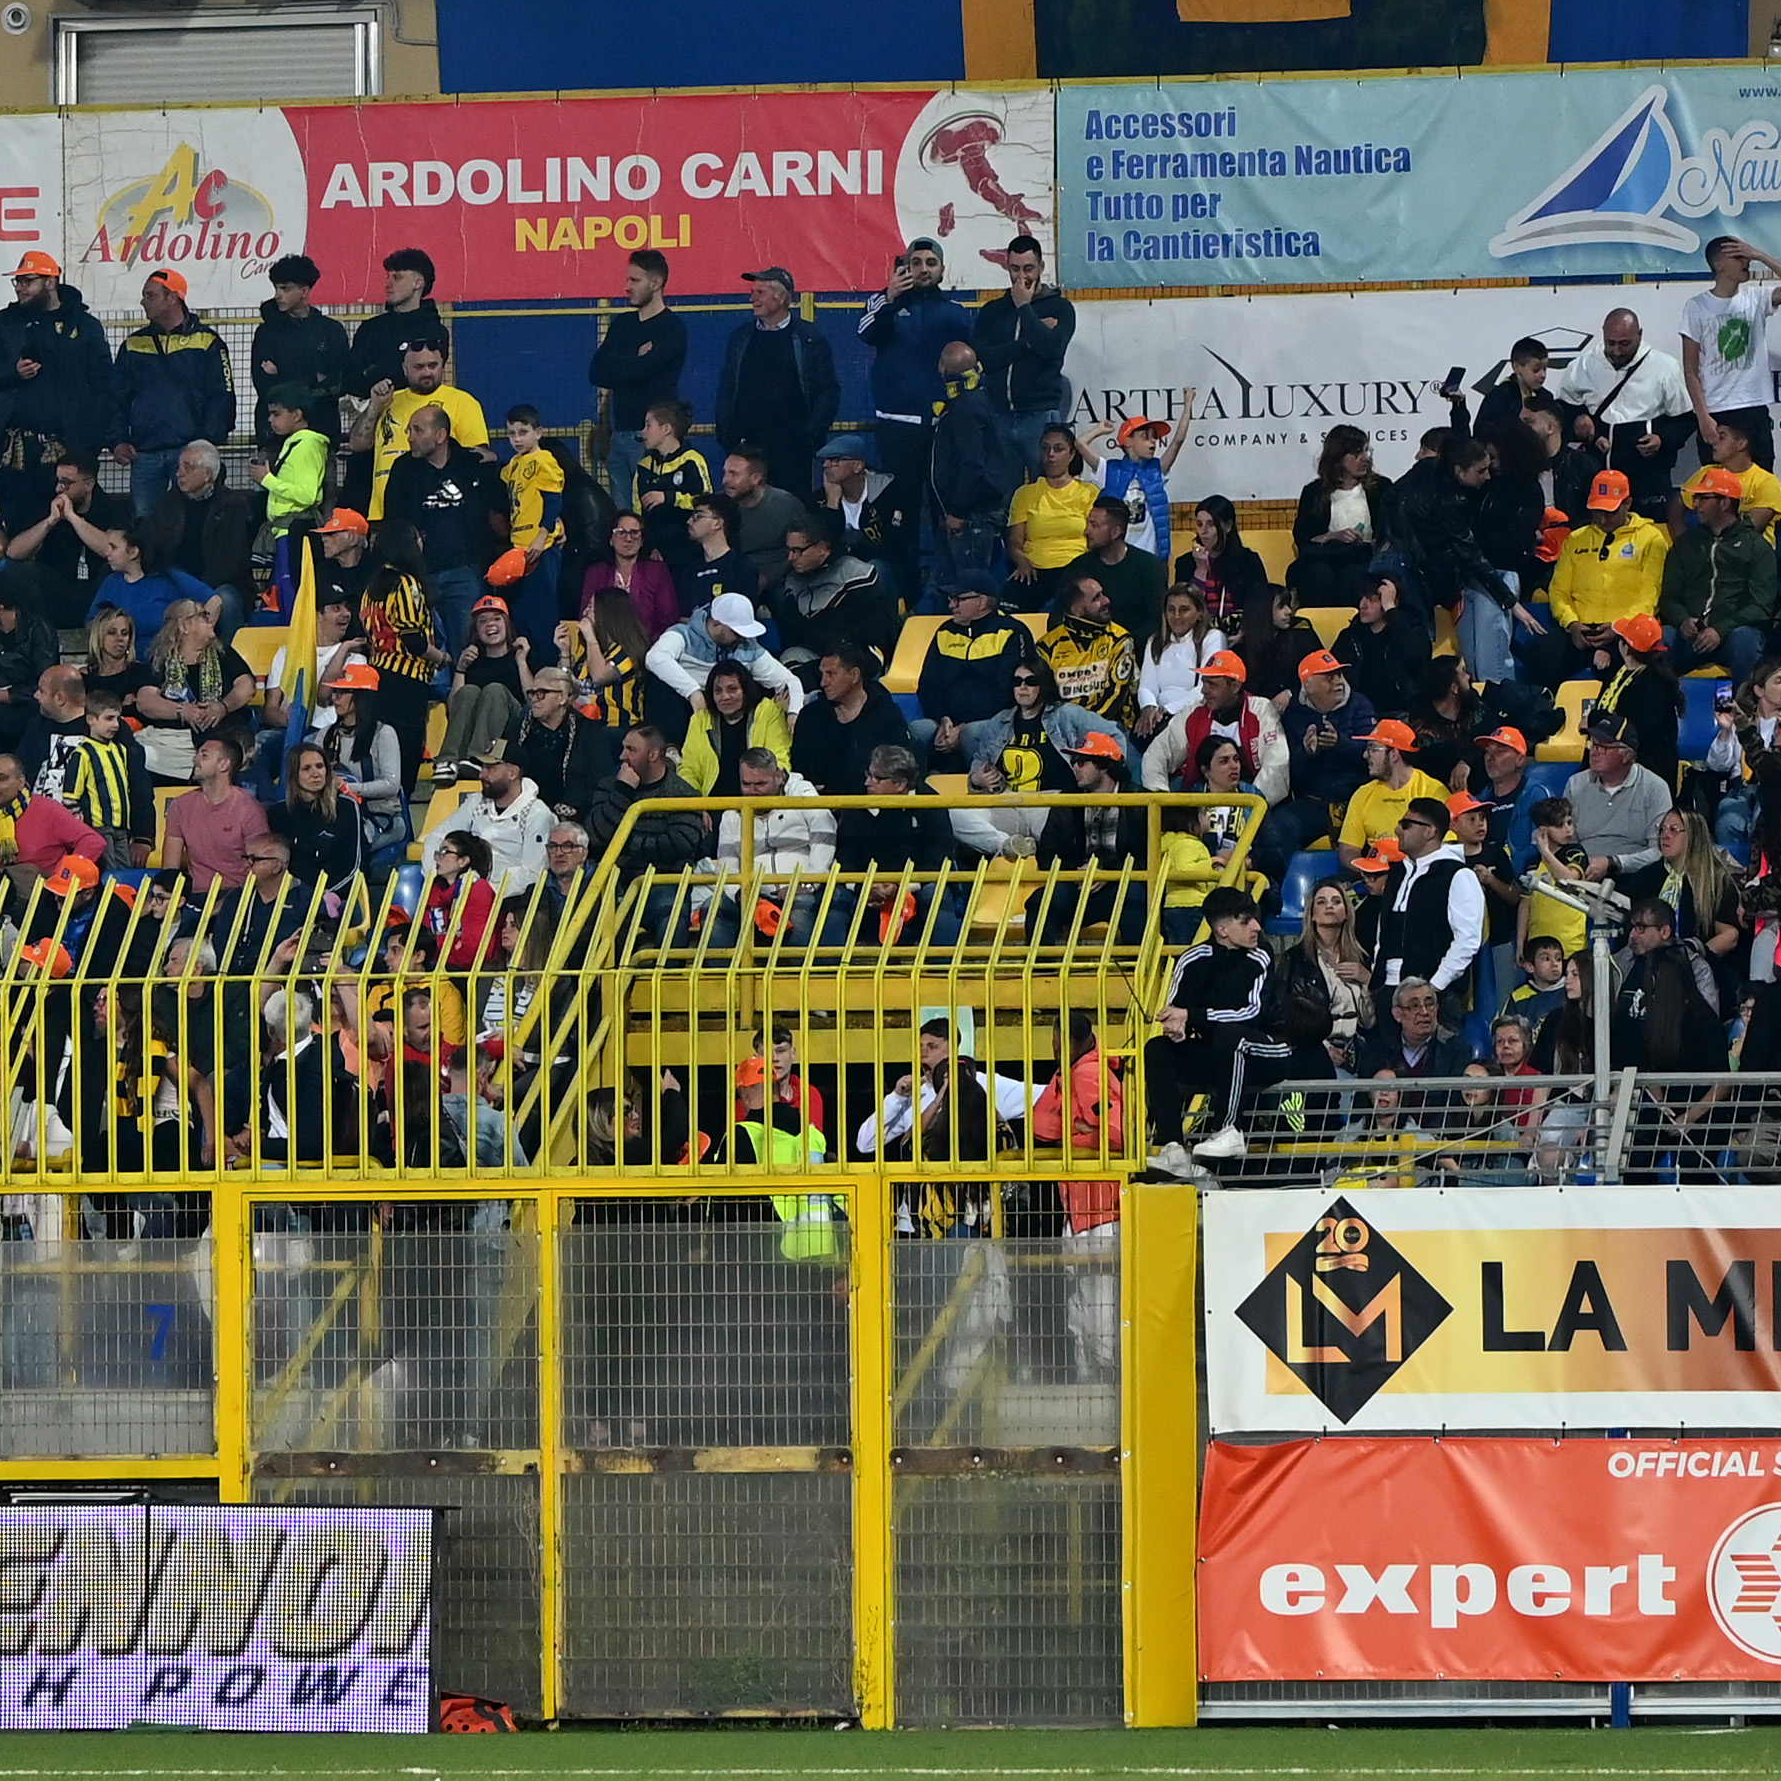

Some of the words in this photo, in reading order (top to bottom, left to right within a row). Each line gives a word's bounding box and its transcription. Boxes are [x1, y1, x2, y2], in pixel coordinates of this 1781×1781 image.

[1085, 106, 1237, 142] Accessori
[321, 152, 662, 211] ARDOLINO
[680, 148, 883, 203] CARNI
[1085, 153, 1104, 177] e
[1111, 146, 1288, 180] Ferramenta
[1294, 142, 1411, 176] Nautica
[1086, 190, 1162, 222] Tutto
[1171, 193, 1222, 225] per
[78, 220, 281, 264] Ardolino
[514, 212, 692, 253] NAPOLI
[1086, 230, 1116, 262] la
[1123, 226, 1321, 262] Cantieristica
[1072, 385, 1227, 424] ARTHA
[1223, 363, 1431, 420] LUXURY
[1194, 431, 1289, 448] COMPANY
[1299, 432, 1309, 444] &
[1315, 1216, 1370, 1254] 20
[1481, 1259, 1628, 1353] LA
[144, 1304, 176, 1361] 7
[1607, 1450, 1765, 1480] OFFICIAL
[1259, 1551, 1677, 1628] expert
[144, 1664, 427, 1711] POWE
